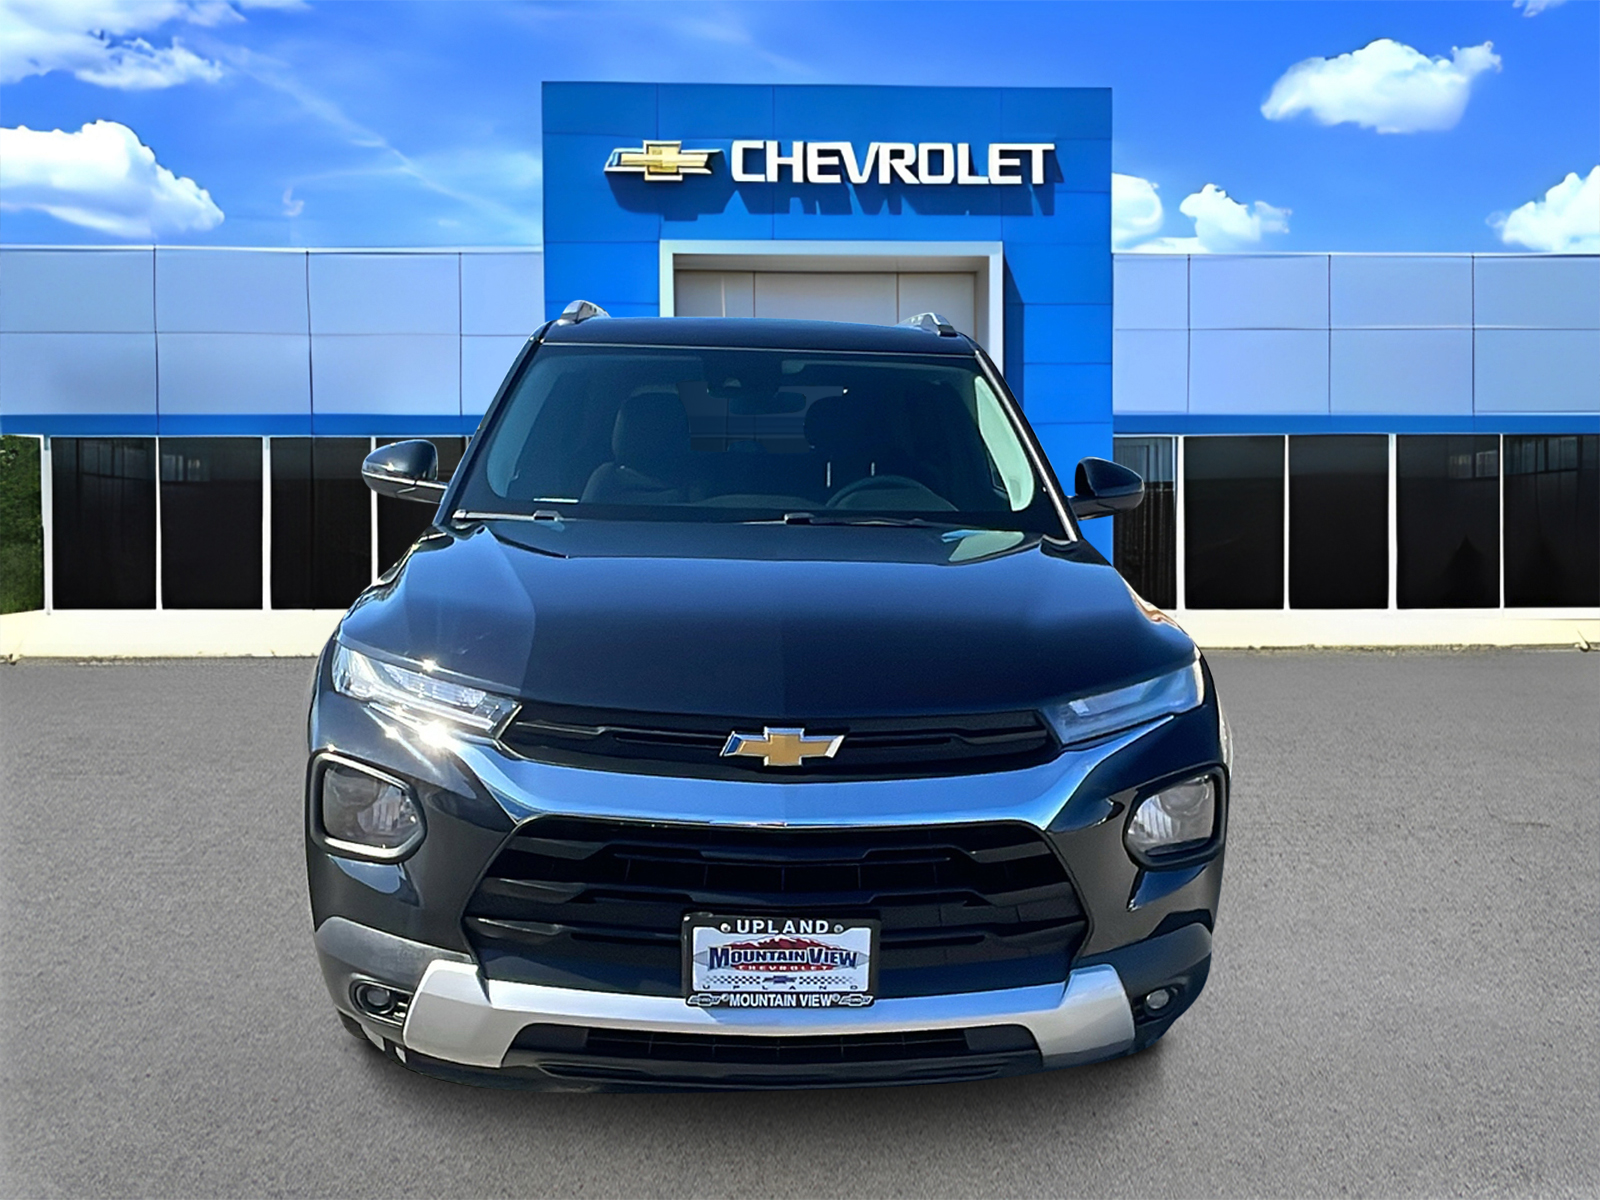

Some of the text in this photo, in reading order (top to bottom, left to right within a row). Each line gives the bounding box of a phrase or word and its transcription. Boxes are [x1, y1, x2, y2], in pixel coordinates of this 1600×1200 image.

[731, 140, 1056, 185] CHEVROLET
[736, 919, 829, 934] UPLAND
[729, 993, 797, 1007] MOUNTAIN
[798, 993, 833, 1007] VIEW
